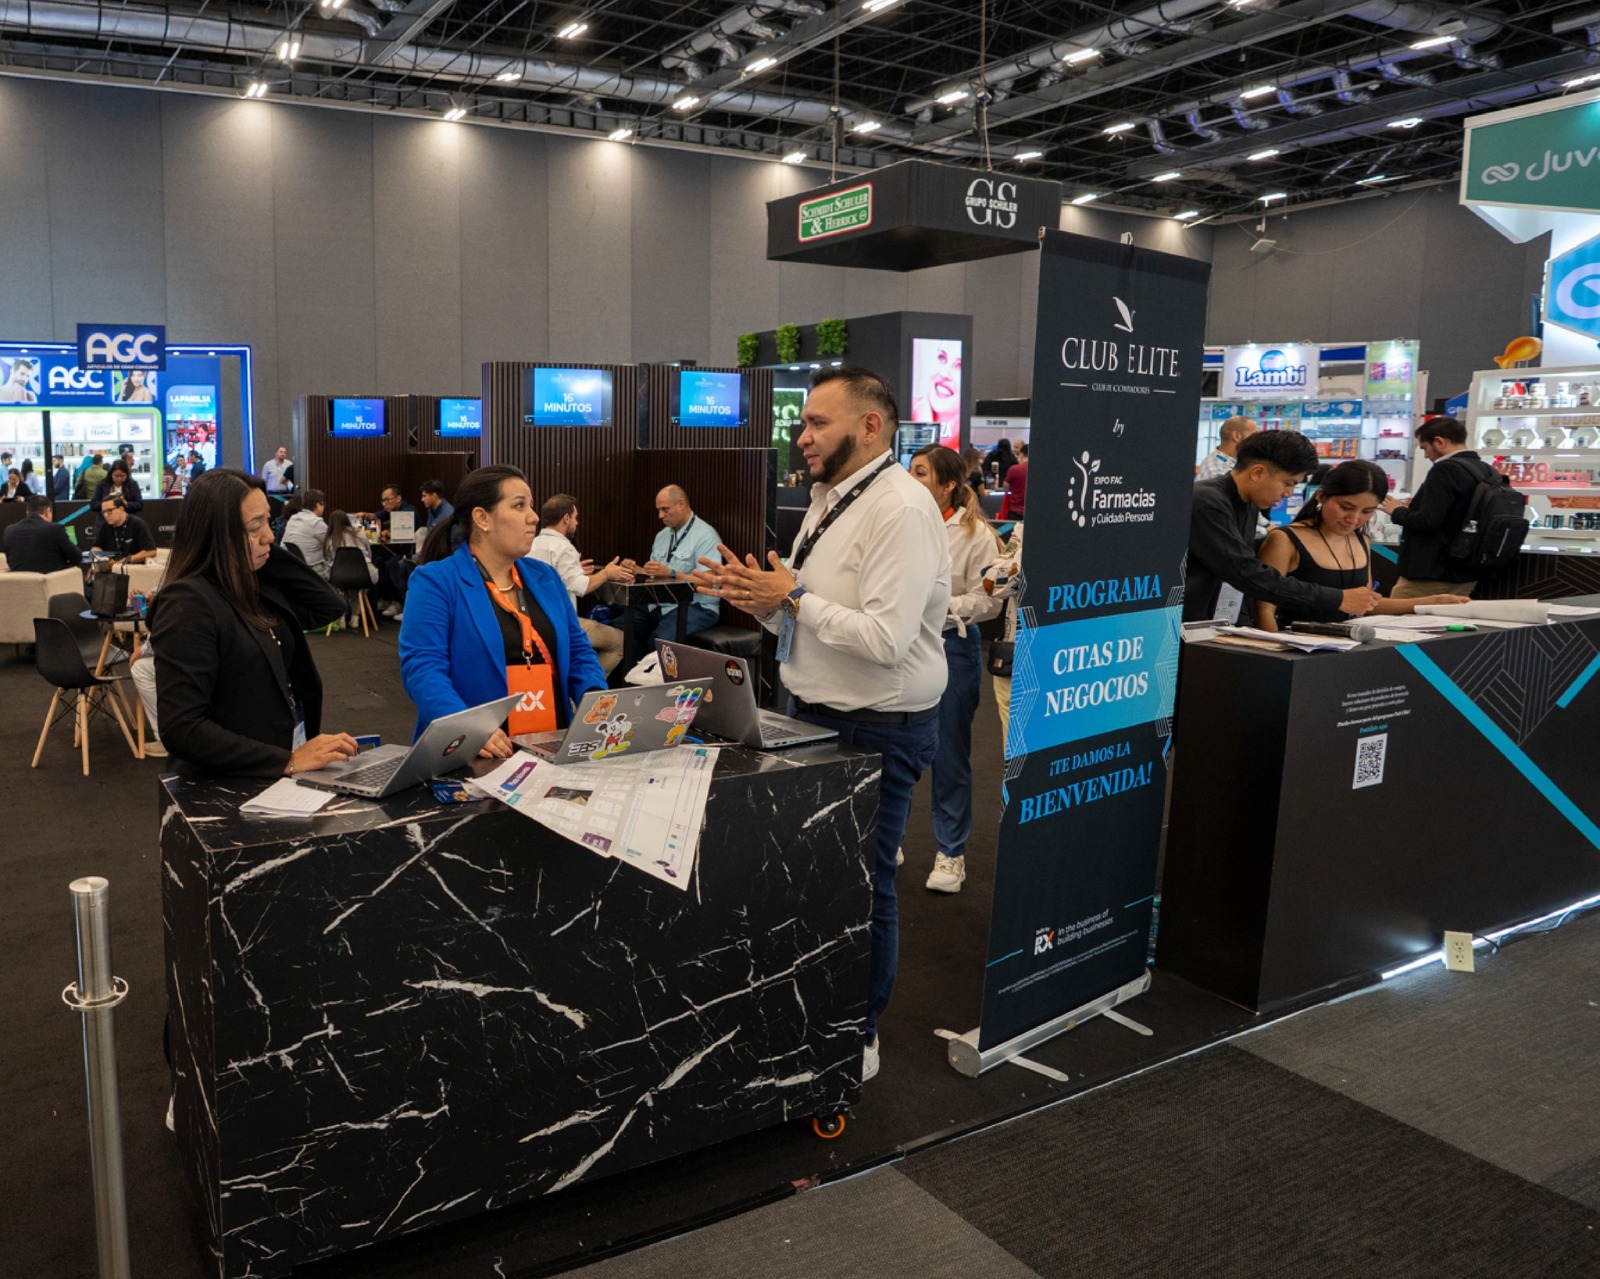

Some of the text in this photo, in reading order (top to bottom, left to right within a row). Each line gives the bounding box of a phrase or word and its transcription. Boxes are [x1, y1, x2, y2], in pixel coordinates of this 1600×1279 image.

[1525, 147, 1600, 181] Juv
[965, 196, 1018, 213] GRUPO SCHULER
[966, 178, 1017, 229] GS
[810, 217, 823, 235] &
[86, 332, 159, 364] AGC
[1060, 337, 1179, 377] CLUB ELITE
[48, 366, 105, 389] AGC
[1234, 364, 1307, 386] Lambi
[544, 403, 592, 414] MINUTOS
[689, 404, 732, 415] MINUTOS
[341, 422, 377, 430] MINUTOS
[447, 422, 481, 430] MINUTOS
[1112, 418, 1125, 437] by
[1092, 487, 1156, 509] Farmacias
[1091, 511, 1155, 527] y Cuidado Personal
[1046, 574, 1162, 613] PROGRAMA
[1053, 636, 1144, 675] CITAS DE
[1044, 671, 1149, 718] NEGOCIOS
[1050, 741, 1132, 777] ¡TE DAMOS LA
[1018, 762, 1153, 825] BIENVENIDA!
[1076, 912, 1102, 929] business
[1034, 929, 1055, 956] RX
[1057, 929, 1082, 946] building
